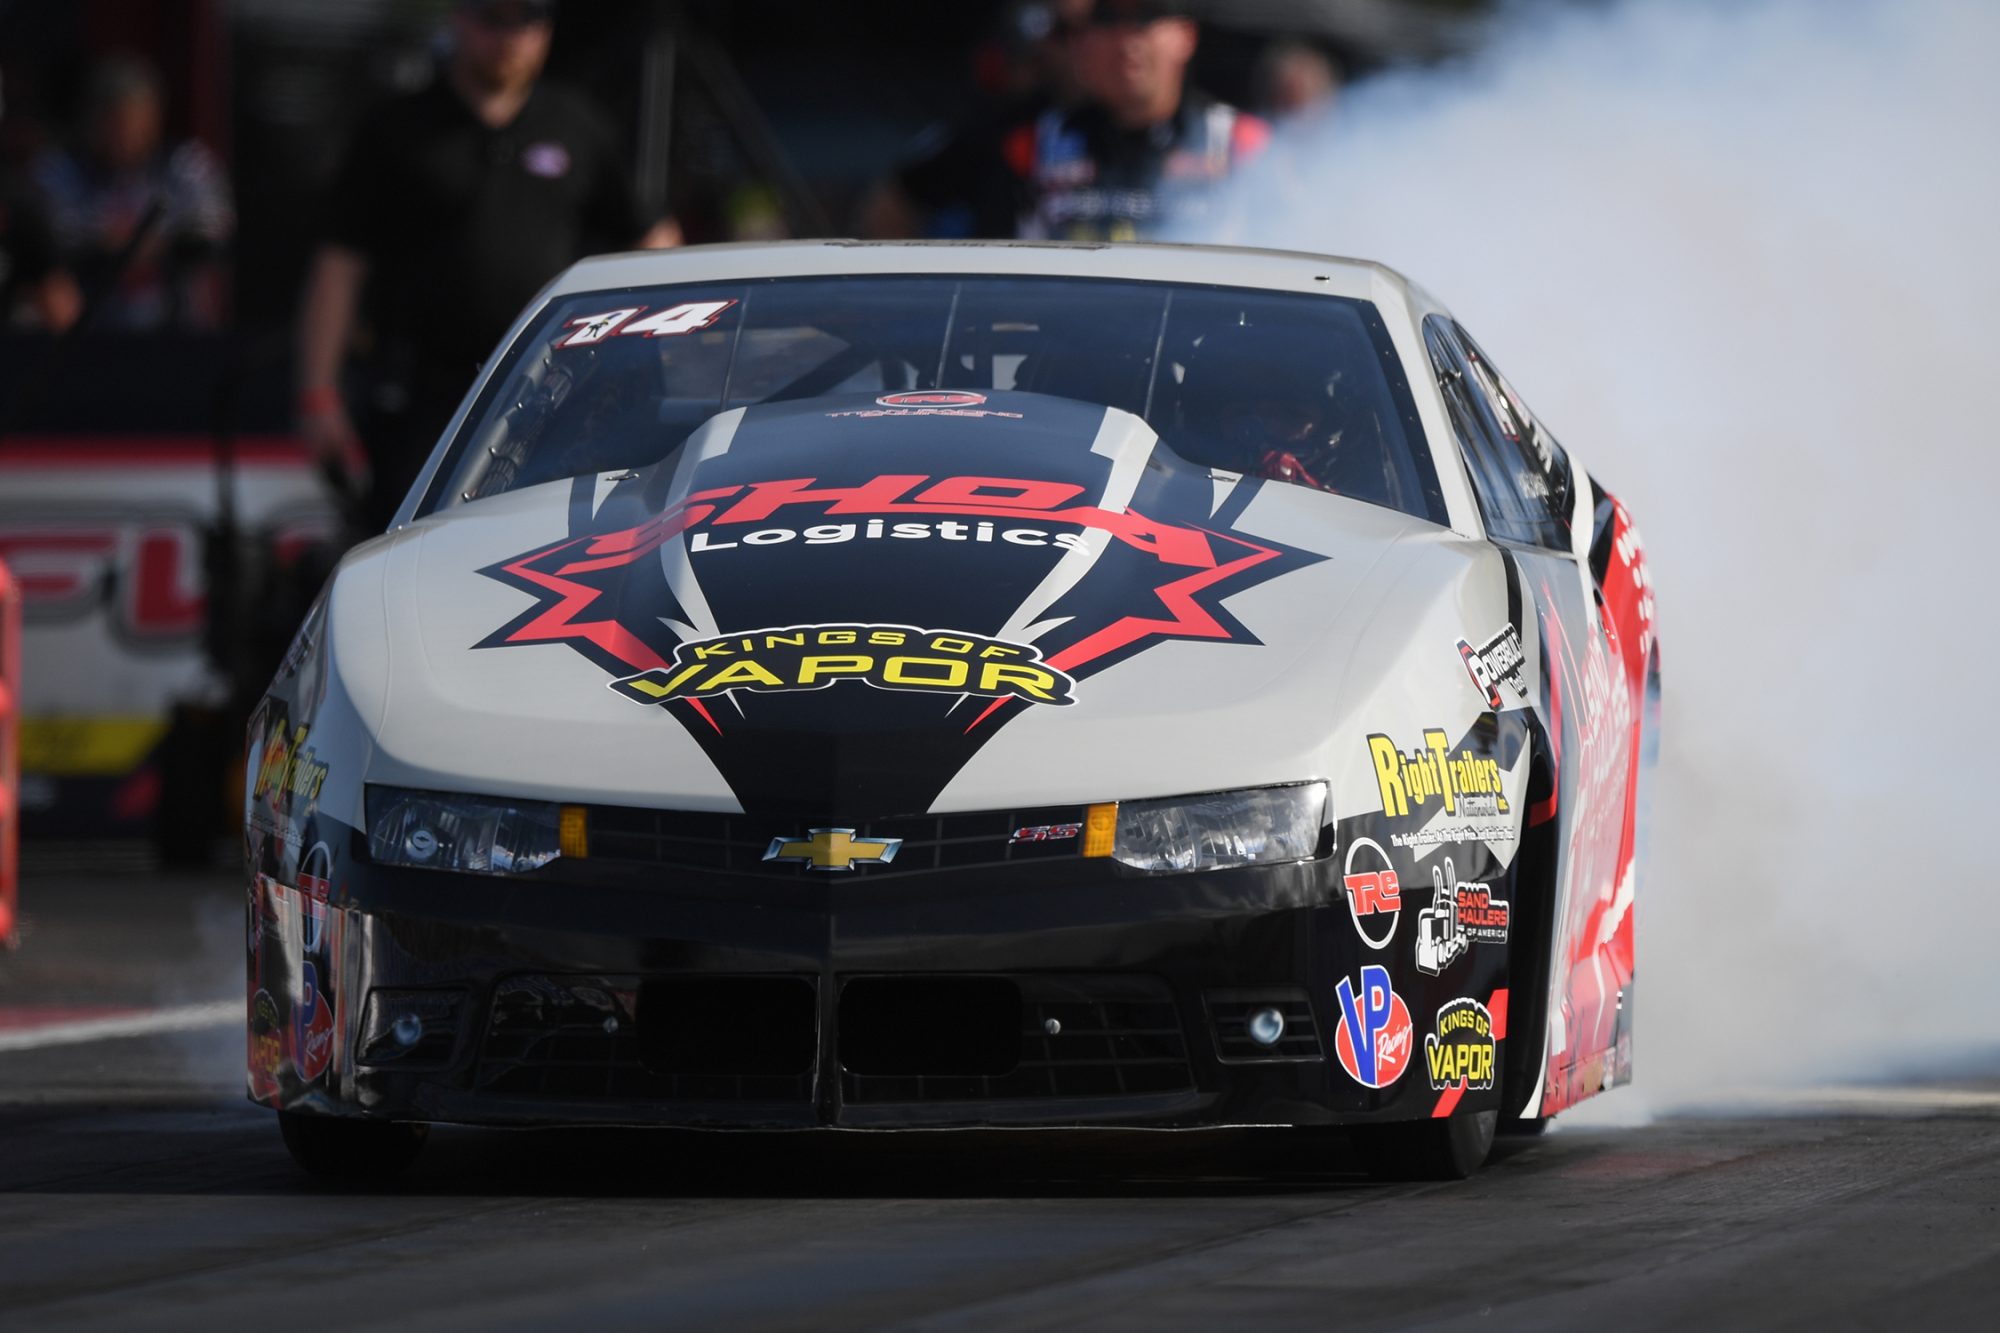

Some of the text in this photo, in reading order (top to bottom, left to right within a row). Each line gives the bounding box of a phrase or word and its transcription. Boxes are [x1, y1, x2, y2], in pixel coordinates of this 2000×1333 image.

[690, 519, 1091, 556] Logistics
[693, 630, 1021, 660] KINGS OF
[627, 655, 1057, 700] VAPOR
[1457, 890, 1489, 909] SAND
[1457, 908, 1508, 927] HAULERS
[1466, 928, 1507, 938] OF AMERICA
[1335, 965, 1393, 1087] VP
[1439, 1010, 1490, 1038] KINGS OF
[1427, 1044, 1494, 1081] VAPOR
